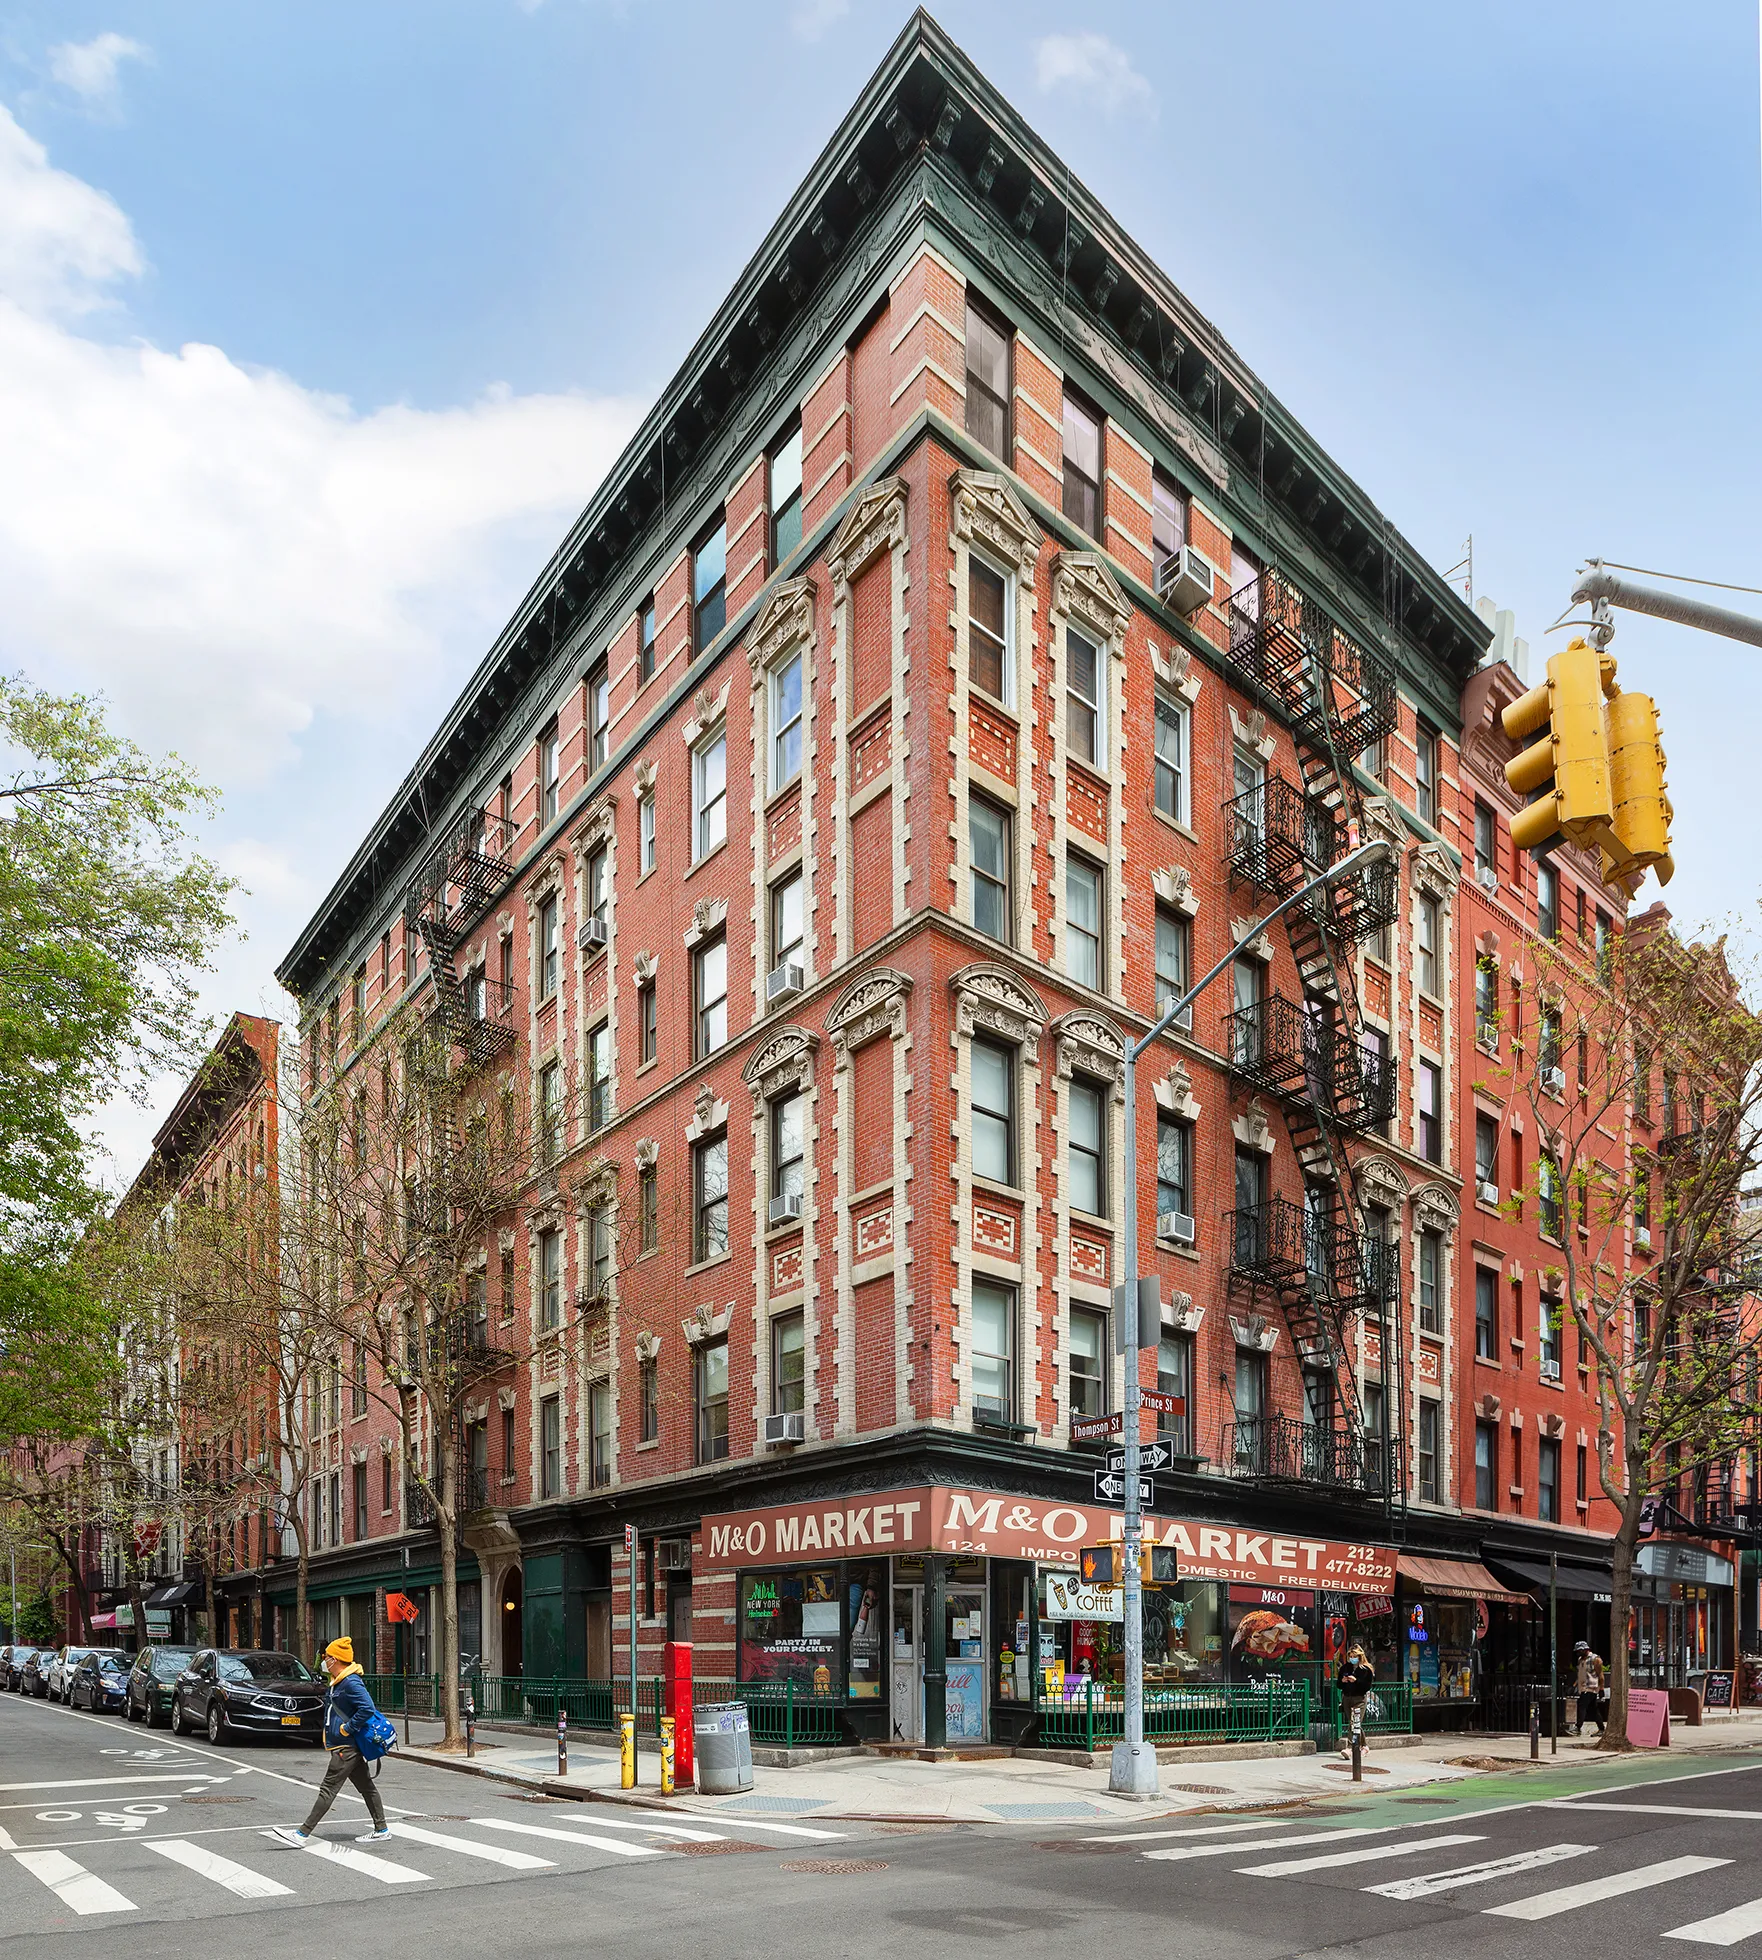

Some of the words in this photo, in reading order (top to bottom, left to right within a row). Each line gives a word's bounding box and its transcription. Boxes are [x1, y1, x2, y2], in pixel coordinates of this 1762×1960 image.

[1140, 1393, 1163, 1410] Prince
[1165, 1398, 1173, 1412] St
[1073, 1421, 1109, 1438] Thompson
[1111, 1417, 1120, 1430] St
[1142, 1450, 1162, 1464] WAY
[1104, 1481, 1122, 1493] ONE
[943, 1494, 1088, 1543] M&O
[709, 1520, 766, 1558] M&O
[775, 1501, 921, 1553] MARKET
[947, 1539, 988, 1553] 124
[1347, 1545, 1375, 1561] 212
[1021, 1546, 1078, 1561] IMPO
[1177, 1564, 1257, 1580] OMESTIC
[1325, 1559, 1392, 1578] 477-8222
[1279, 1575, 1318, 1586] FREE
[1321, 1580, 1388, 1593] DELIVERY
[746, 1600, 762, 1609] NEW
[763, 1600, 780, 1608] YORK
[1076, 1594, 1113, 1612] COFFEE
[1261, 1589, 1286, 1605] M&O
[1358, 1596, 1388, 1615] ATM
[791, 1645, 834, 1653] POCKET.
[945, 1674, 973, 1689] ill
[1707, 1686, 1730, 1698] CAFÉ
[946, 1713, 963, 1721] GHT
